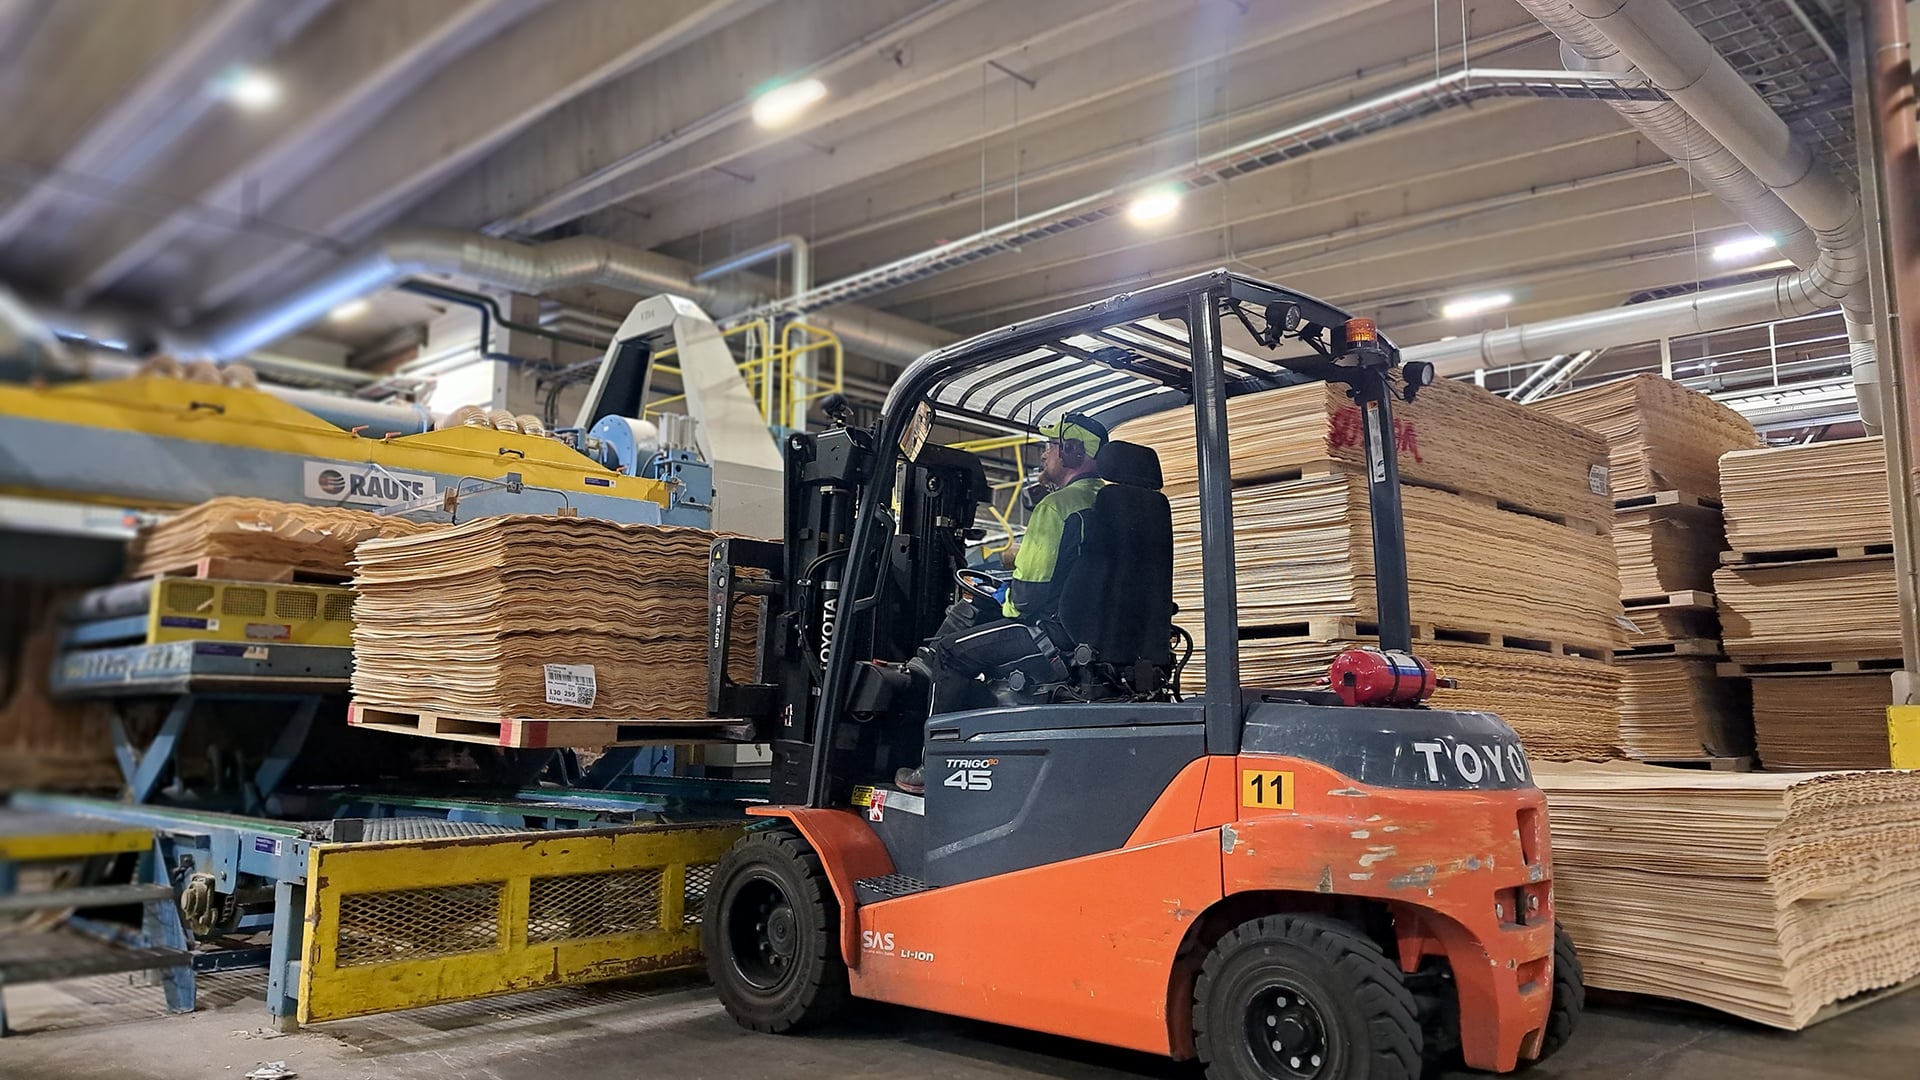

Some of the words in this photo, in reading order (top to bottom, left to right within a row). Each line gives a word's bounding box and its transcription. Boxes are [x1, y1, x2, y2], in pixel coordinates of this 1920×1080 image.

[820, 598, 837, 671] OYOTA
[1414, 743, 1525, 783] TOYO
[943, 769, 993, 791] 45
[1251, 774, 1283, 805] 11
[862, 930, 895, 951] SAS
